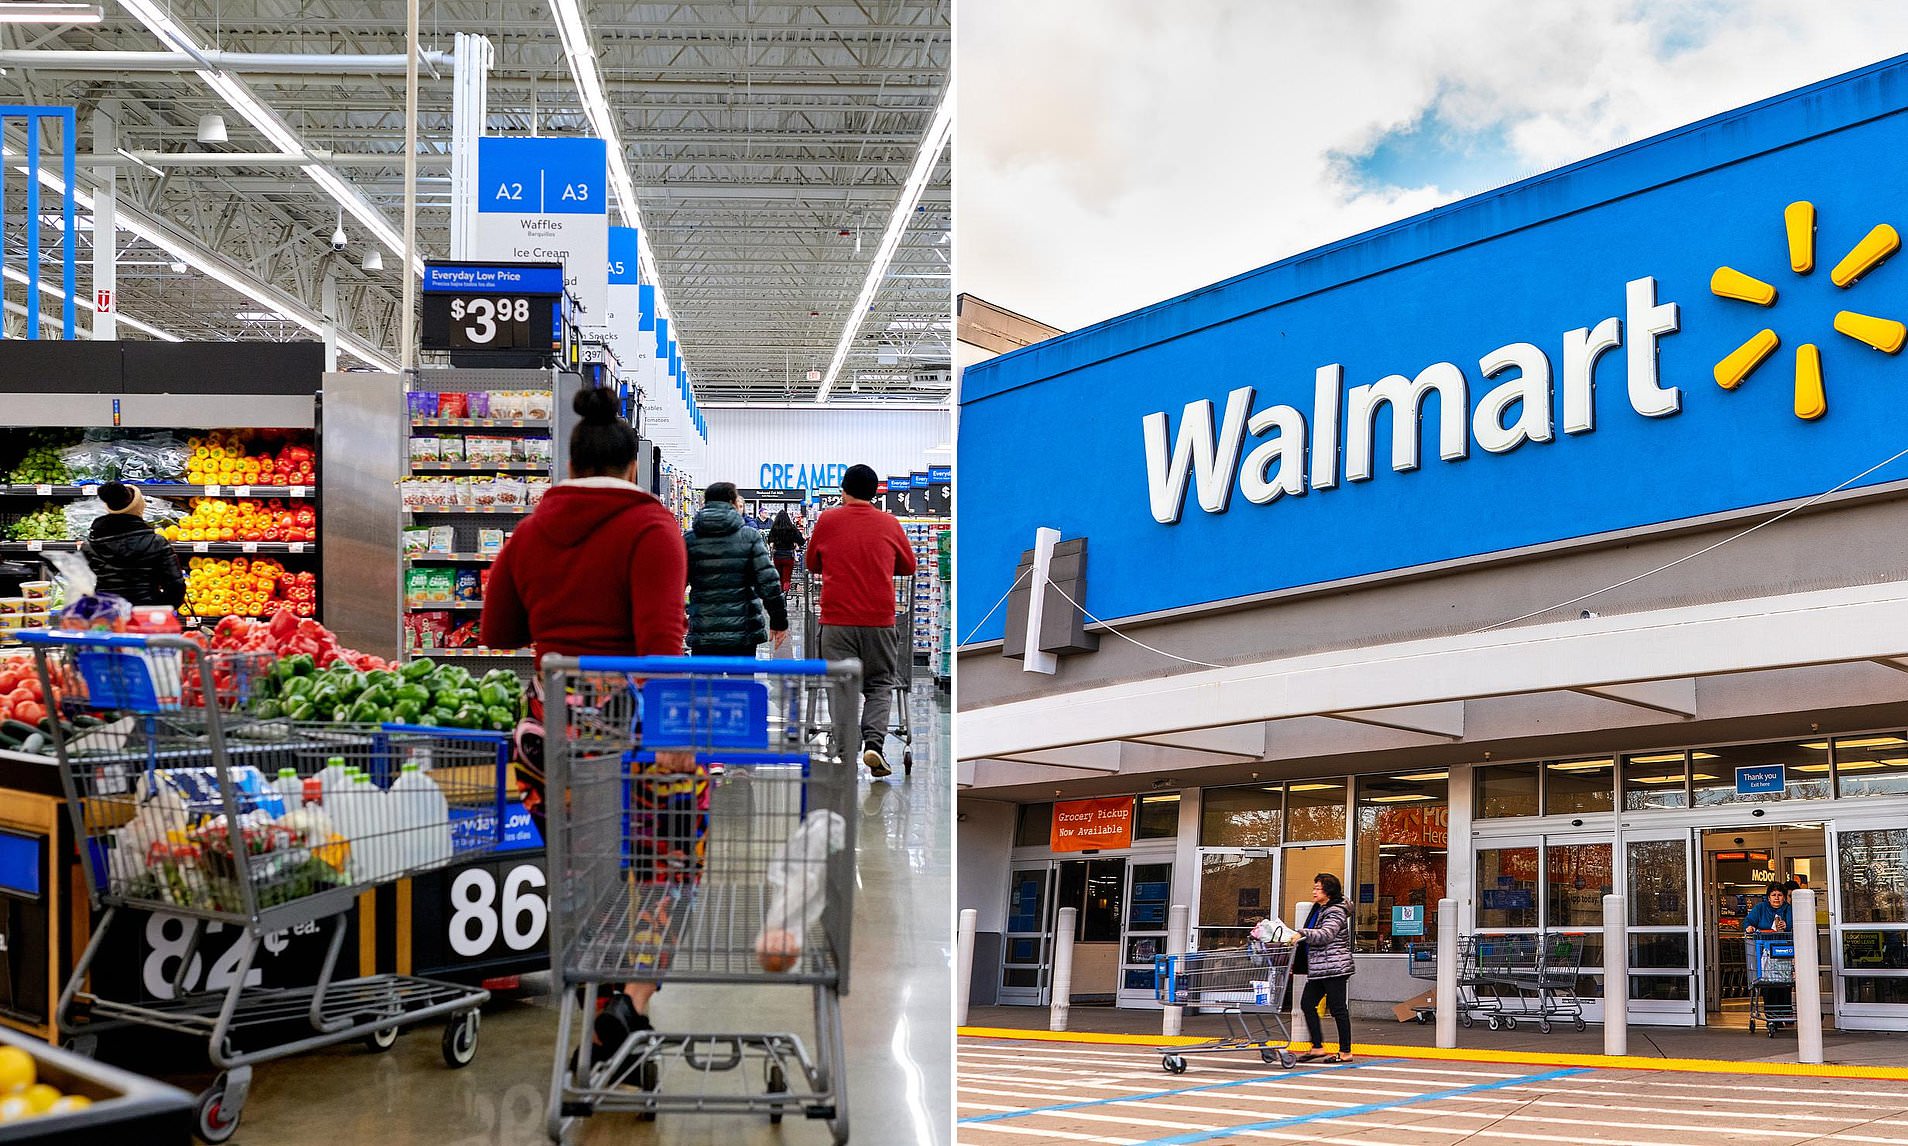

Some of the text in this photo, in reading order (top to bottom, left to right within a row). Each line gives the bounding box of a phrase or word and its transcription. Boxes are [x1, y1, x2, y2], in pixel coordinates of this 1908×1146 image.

[496, 183, 523, 200] A2
[562, 184, 589, 201] A3
[521, 219, 562, 229] Waffles
[514, 247, 570, 257] Ice Cream
[607, 261, 625, 275] A5
[432, 270, 521, 282] Everyday Low Price
[589, 332, 618, 341] Snacks
[1143, 275, 1681, 525] Walmart
[1744, 773, 1777, 781] Thank you
[1058, 809, 1129, 823] Grocery Pickup
[1059, 825, 1123, 837] Now Available
[449, 864, 551, 957] 86
